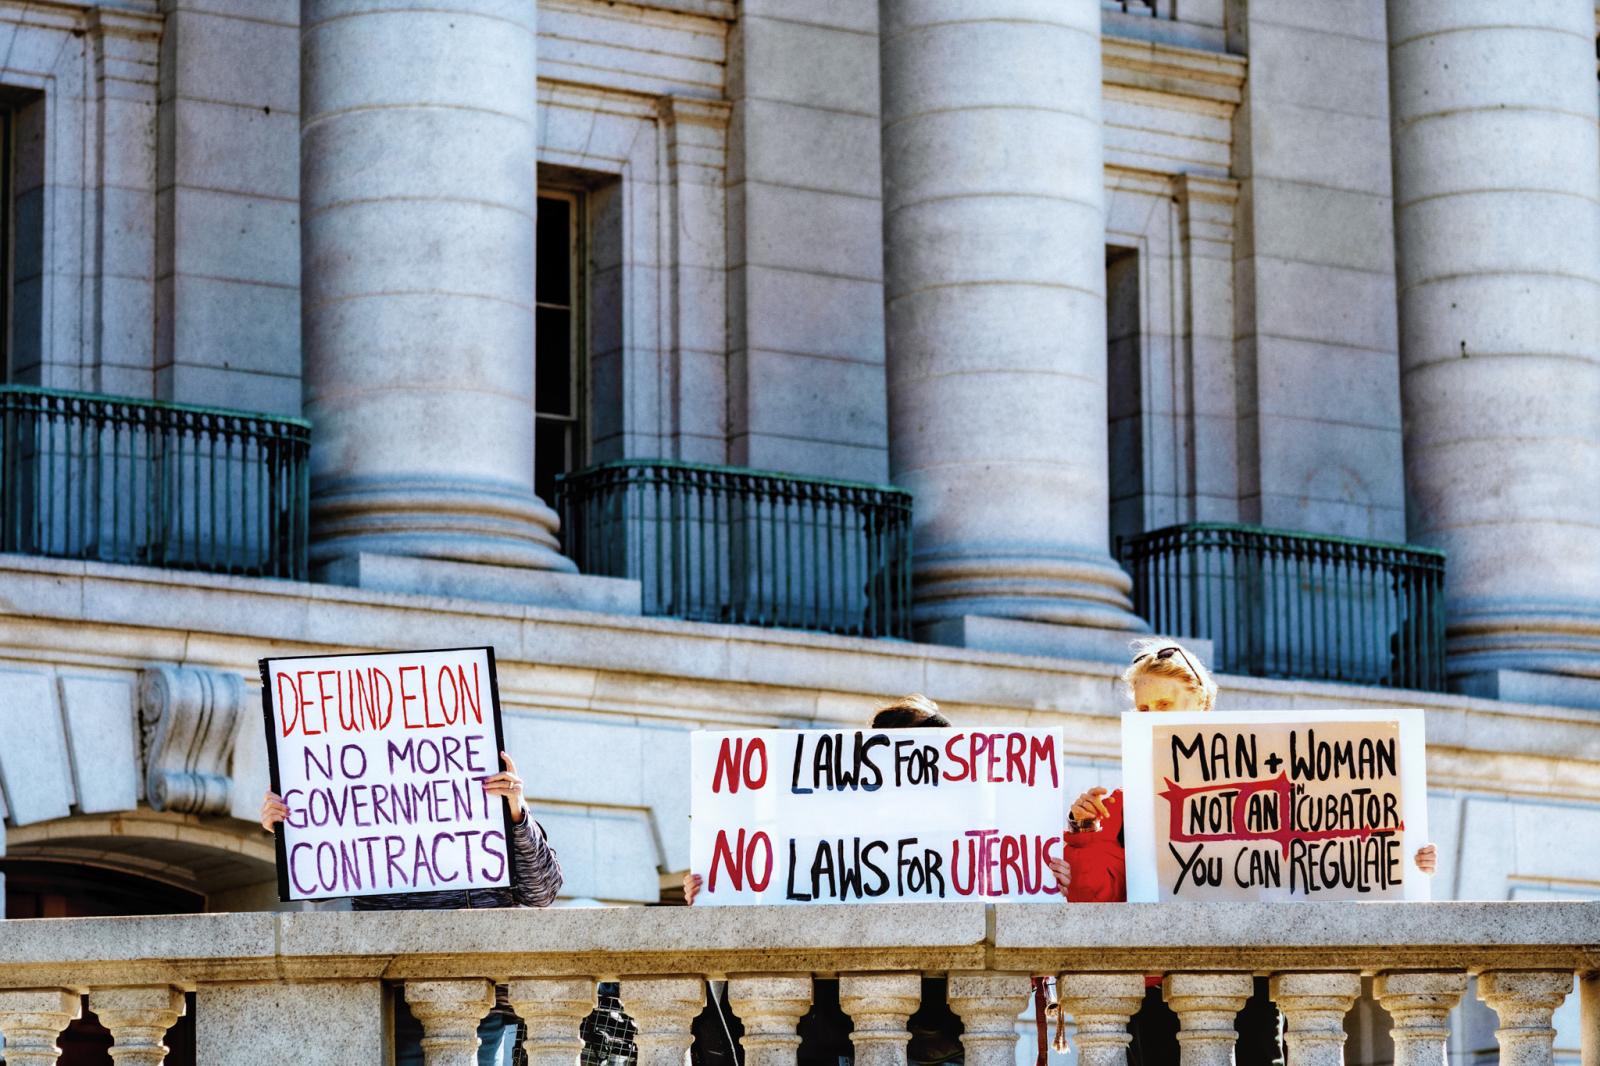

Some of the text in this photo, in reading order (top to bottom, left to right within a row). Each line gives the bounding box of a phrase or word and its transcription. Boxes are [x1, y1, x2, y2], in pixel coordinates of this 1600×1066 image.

[277, 662, 483, 737] DEFUND ELON
[304, 735, 486, 780] NO MORE
[713, 732, 1058, 793] NO LAWS FOR SPERM
[1171, 732, 1257, 782] MAN
[1290, 729, 1397, 781] WOMAN
[284, 776, 491, 828] GOVERNMENT
[1190, 791, 1238, 834] NOT
[1248, 792, 1278, 832] AN
[290, 830, 505, 894] CONTRACTS
[708, 828, 1061, 901] NO LAWS FOR UTERUS
[1234, 847, 1280, 888] CAN
[1290, 831, 1402, 895] REGULATE
